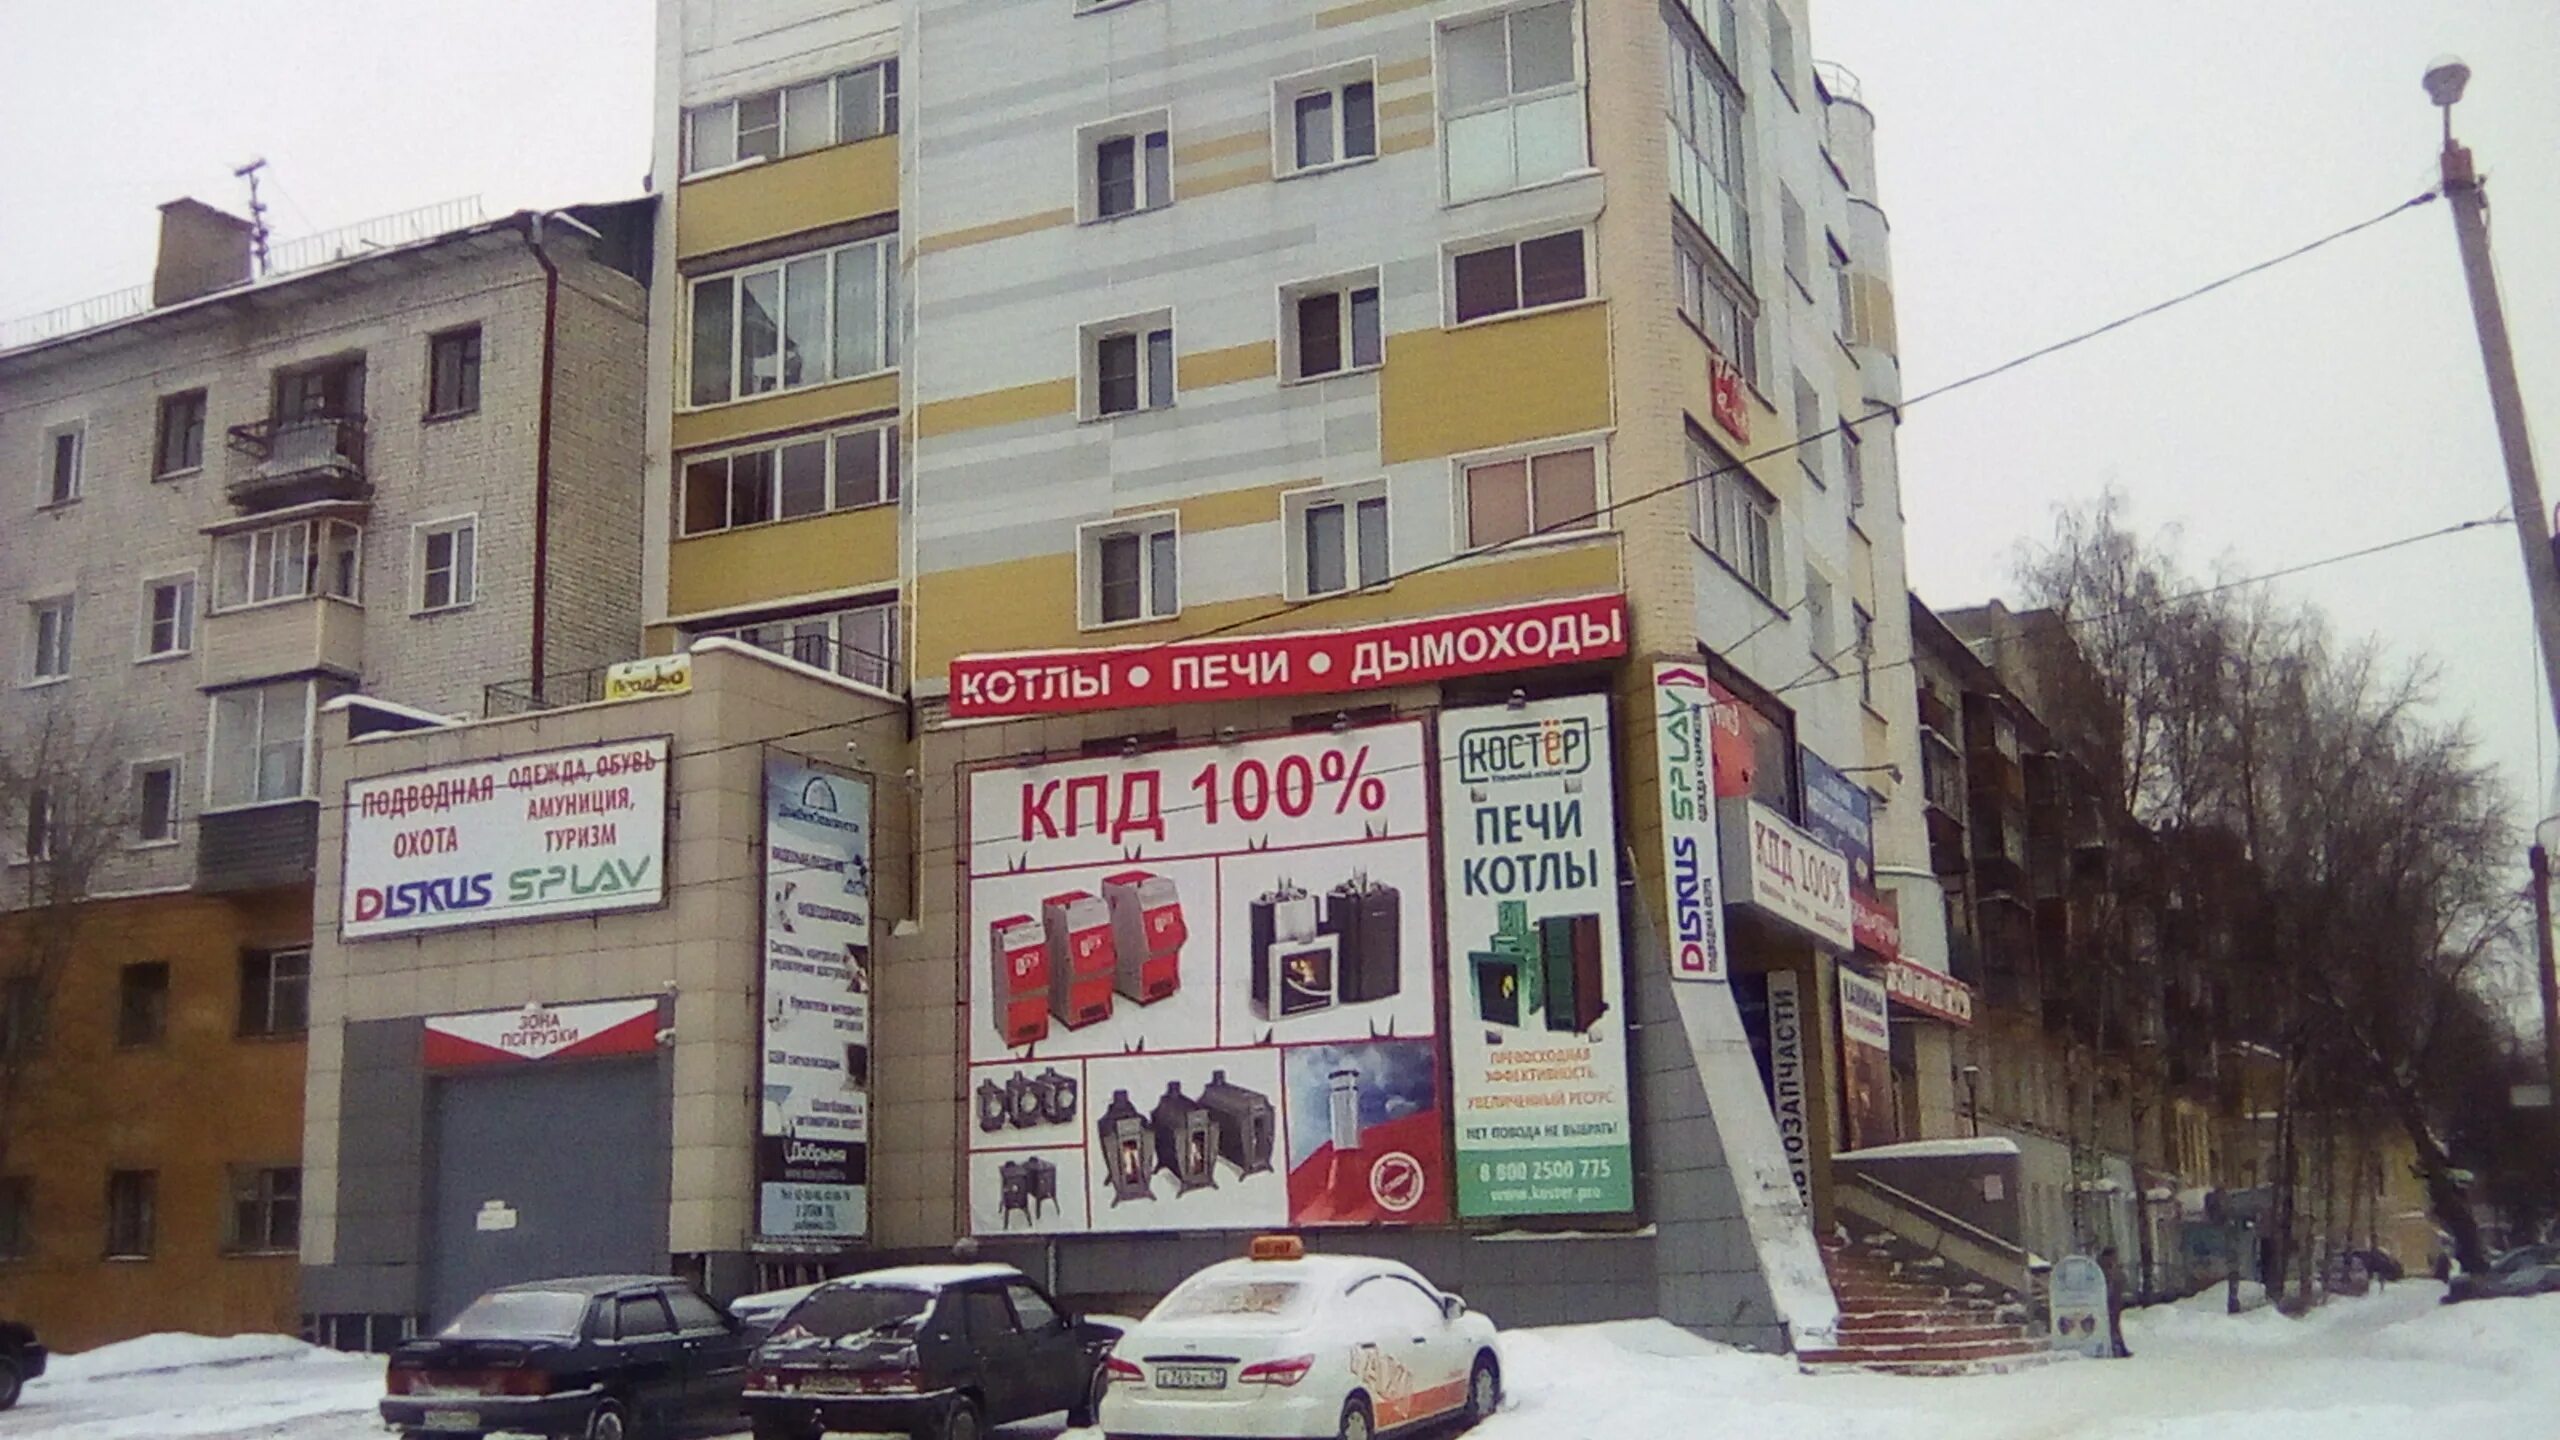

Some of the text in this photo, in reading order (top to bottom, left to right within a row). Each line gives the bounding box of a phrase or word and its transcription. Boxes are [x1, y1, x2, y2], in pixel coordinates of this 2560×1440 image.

[959, 608, 1622, 705] КОТЛЫ ПЕЧИ ДЫМОХОДЫ
[596, 749, 656, 778] ОБУВЬ
[1664, 688, 1695, 822] SPLAV
[361, 774, 494, 819] ПОДВОДНАЯ
[1021, 745, 1386, 845] КПД 100%
[393, 825, 458, 859] ОХОТА
[544, 823, 617, 853] ТУРИЗМ
[1476, 800, 1582, 845] ПЕЧИ
[508, 855, 651, 901] SPLAV
[1463, 849, 1598, 896] КОТЛЫ
[1755, 820, 1797, 892] КПД
[1799, 846, 1845, 910] 100%
[356, 873, 494, 922] DISKUS
[1673, 836, 1705, 972] DISKUS
[500, 1028, 579, 1048] ПОГРУЗКИ
[518, 1013, 561, 1030] ЗОНА
[1479, 1162, 1491, 1182] 8
[1532, 1159, 1575, 1180] 2500
[1578, 1158, 1612, 1179] 775
